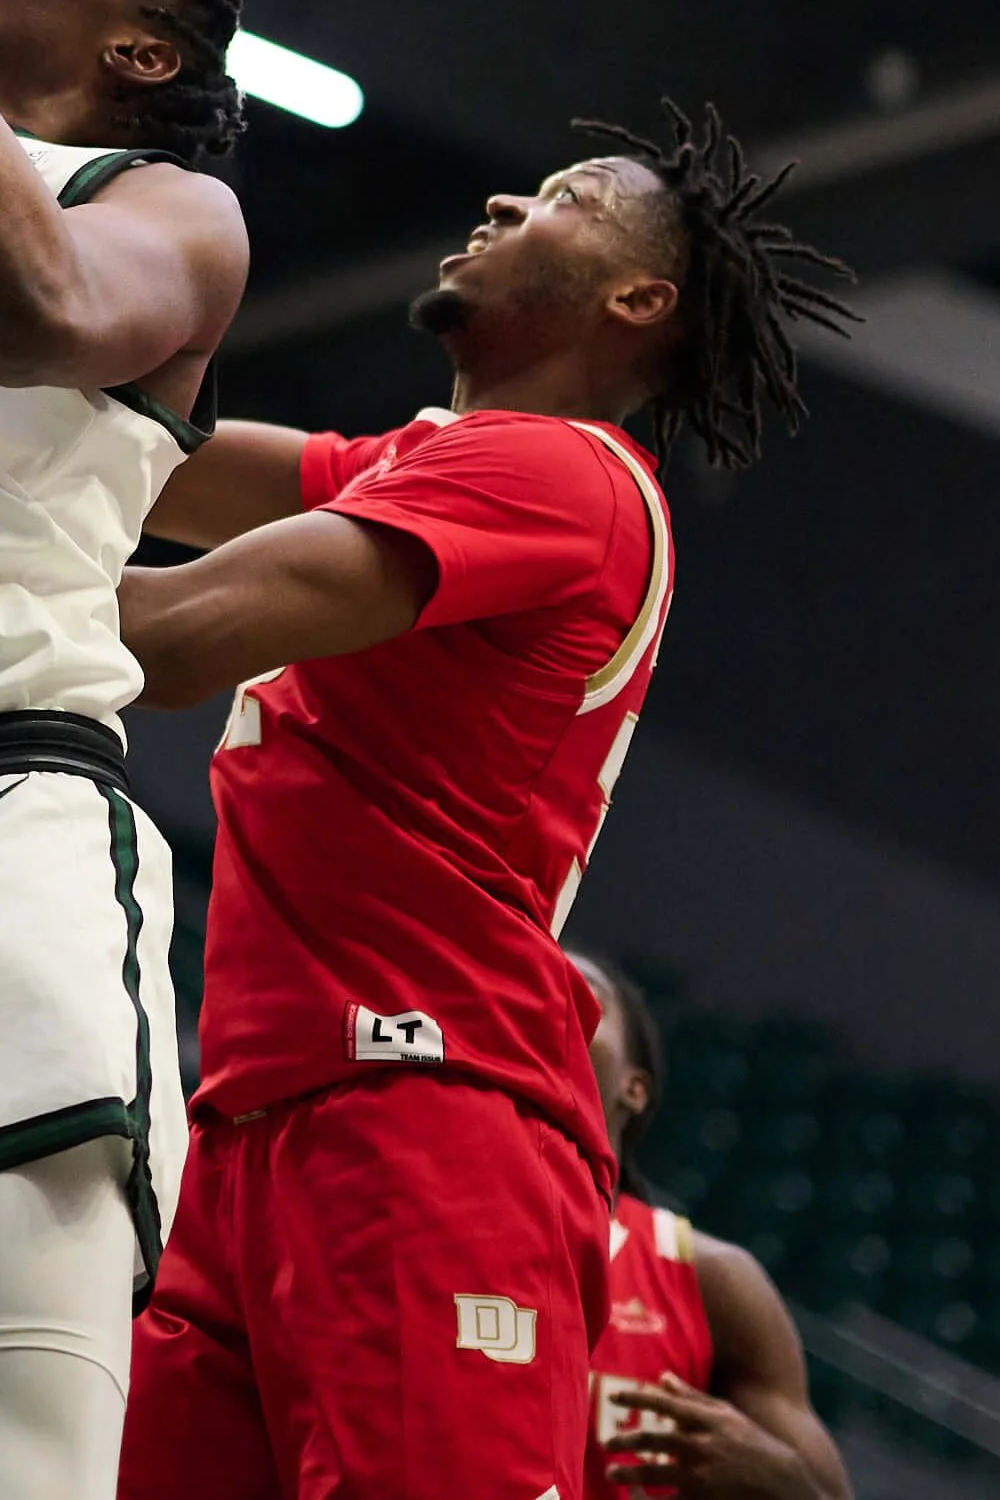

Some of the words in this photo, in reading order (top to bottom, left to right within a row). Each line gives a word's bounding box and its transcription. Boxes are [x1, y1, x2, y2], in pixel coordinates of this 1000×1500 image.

[371, 1017, 423, 1045] LT
[400, 1053, 420, 1061] TEAM
[454, 1293, 538, 1365] DU
